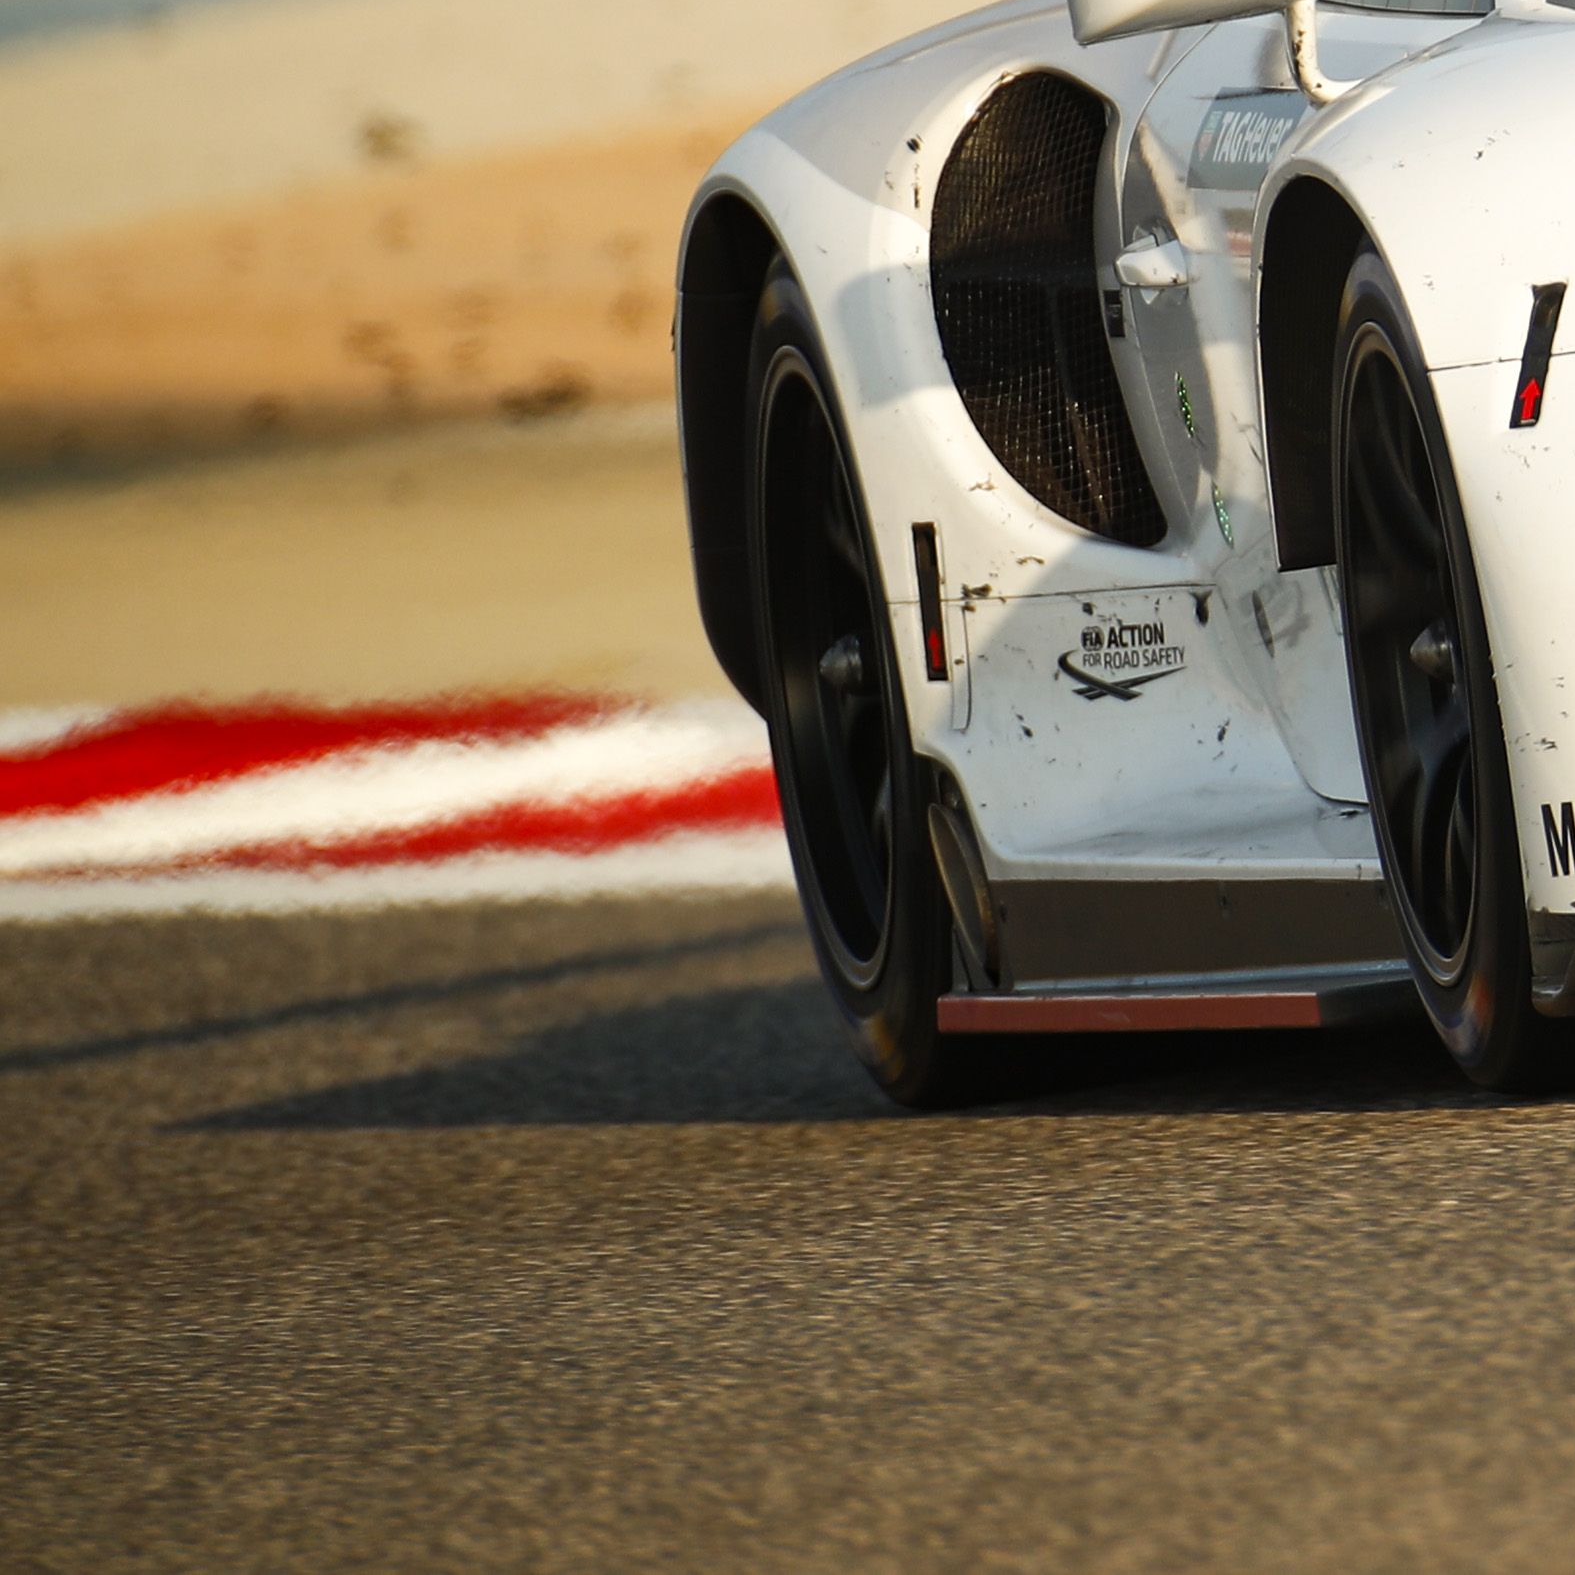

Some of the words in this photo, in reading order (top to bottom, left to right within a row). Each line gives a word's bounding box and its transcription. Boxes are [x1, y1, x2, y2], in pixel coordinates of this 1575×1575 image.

[1107, 622, 1165, 649] ACTION
[1083, 652, 1102, 667] FOR
[1104, 650, 1140, 670] ROAD
[1142, 646, 1186, 667] SAFETY
